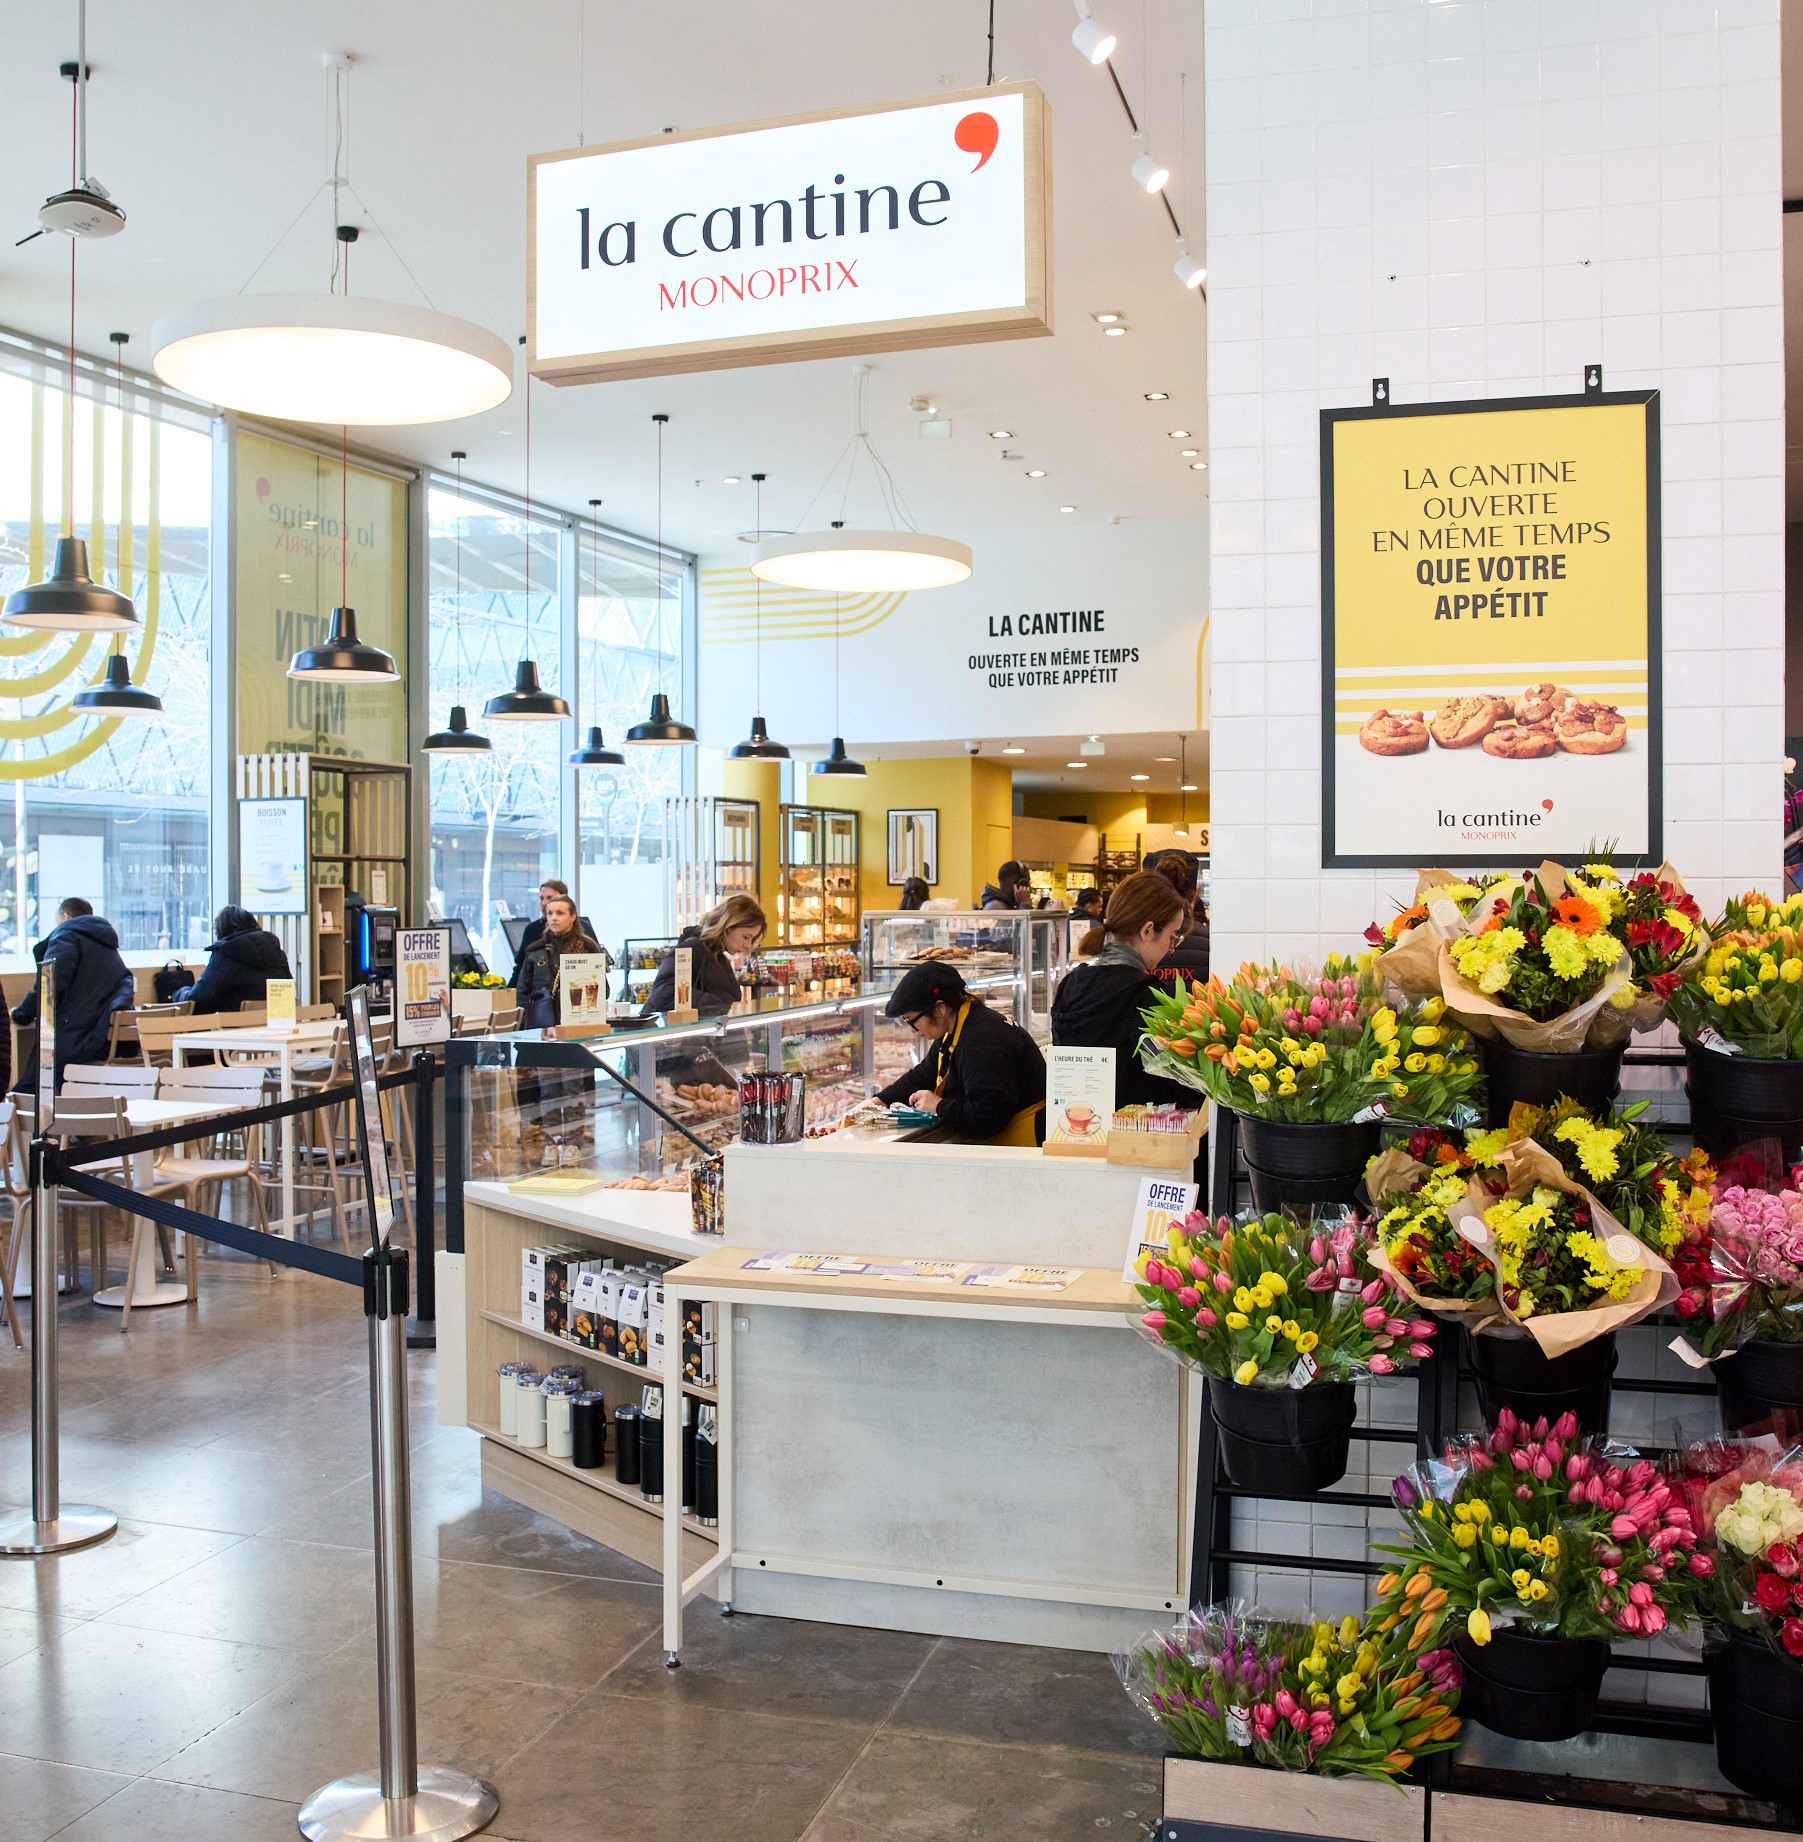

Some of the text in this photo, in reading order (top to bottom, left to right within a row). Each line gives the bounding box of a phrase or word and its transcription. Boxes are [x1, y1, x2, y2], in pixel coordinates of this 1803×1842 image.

[575, 173, 951, 270] la cantine
[658, 258, 859, 311] MONOPRIX
[1402, 460, 1577, 490] LA CANTINE
[1423, 492, 1558, 519] OUVERTE
[1372, 521, 1611, 552] EN MÊME TEMPS
[1416, 554, 1567, 587] QUE VOTRE
[1434, 587, 1548, 620] APPÉTIT
[989, 610, 1105, 637] LA CANTINE
[968, 647, 1139, 670] OUVERTE EN MÊME TEMPS
[988, 666, 1118, 689] QUE VOTRE APPÉTIT
[596, 780, 615, 791] BUS
[257, 808, 287, 817] BOISSON
[1437, 809, 1542, 827] la cantine
[1461, 831, 1517, 840] MONOPRIX
[403, 933, 441, 952] OFFRE
[403, 952, 441, 961] DE LANCEMENT
[405, 962, 439, 1002] 10%
[1147, 1199, 1184, 1211] DE LANCEMENT
[1149, 1183, 1187, 1204] OFFRE
